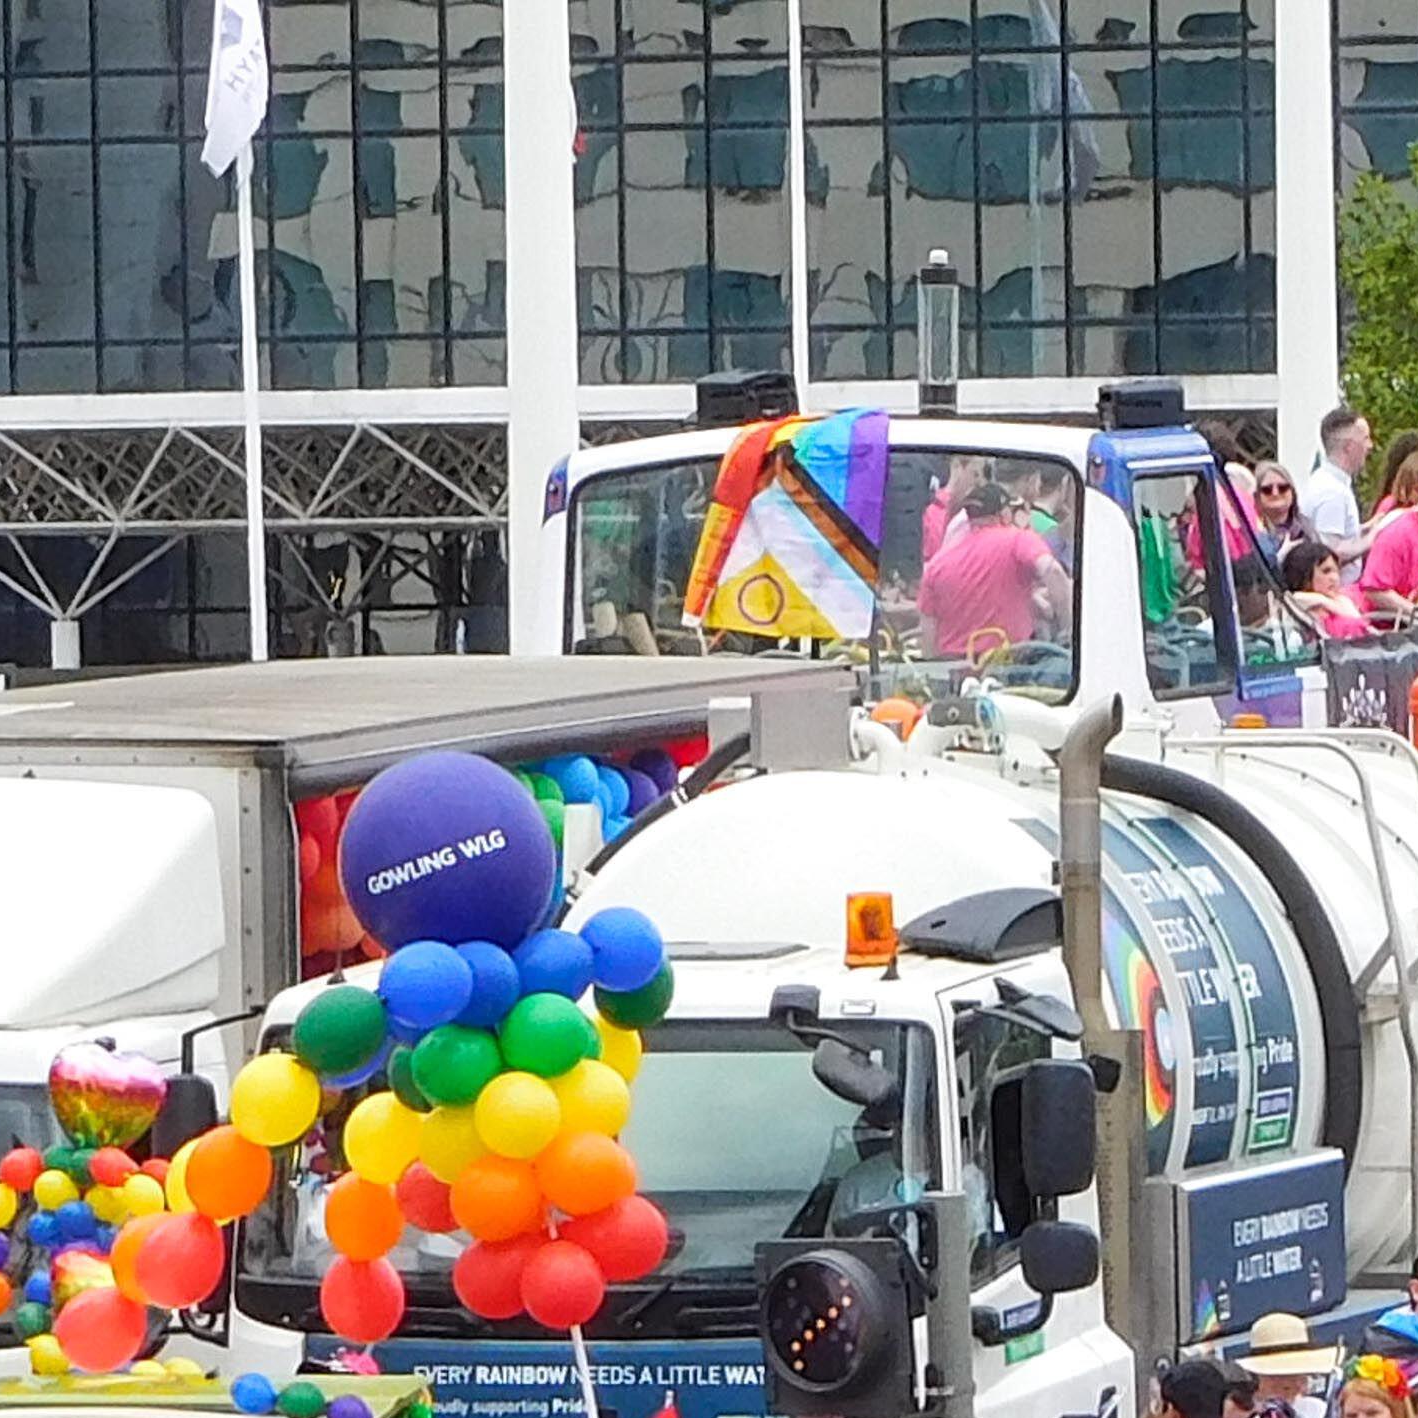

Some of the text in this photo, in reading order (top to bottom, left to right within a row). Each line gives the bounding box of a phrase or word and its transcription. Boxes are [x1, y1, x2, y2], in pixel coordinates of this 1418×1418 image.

[367, 829, 506, 895] GOWLING WLG
[476, 1366, 567, 1385] RAINBOW
[638, 1366, 653, 1385] A
[656, 1366, 721, 1385] LITTLE
[723, 1365, 765, 1385] WAT
[552, 1397, 587, 1414] Prid
